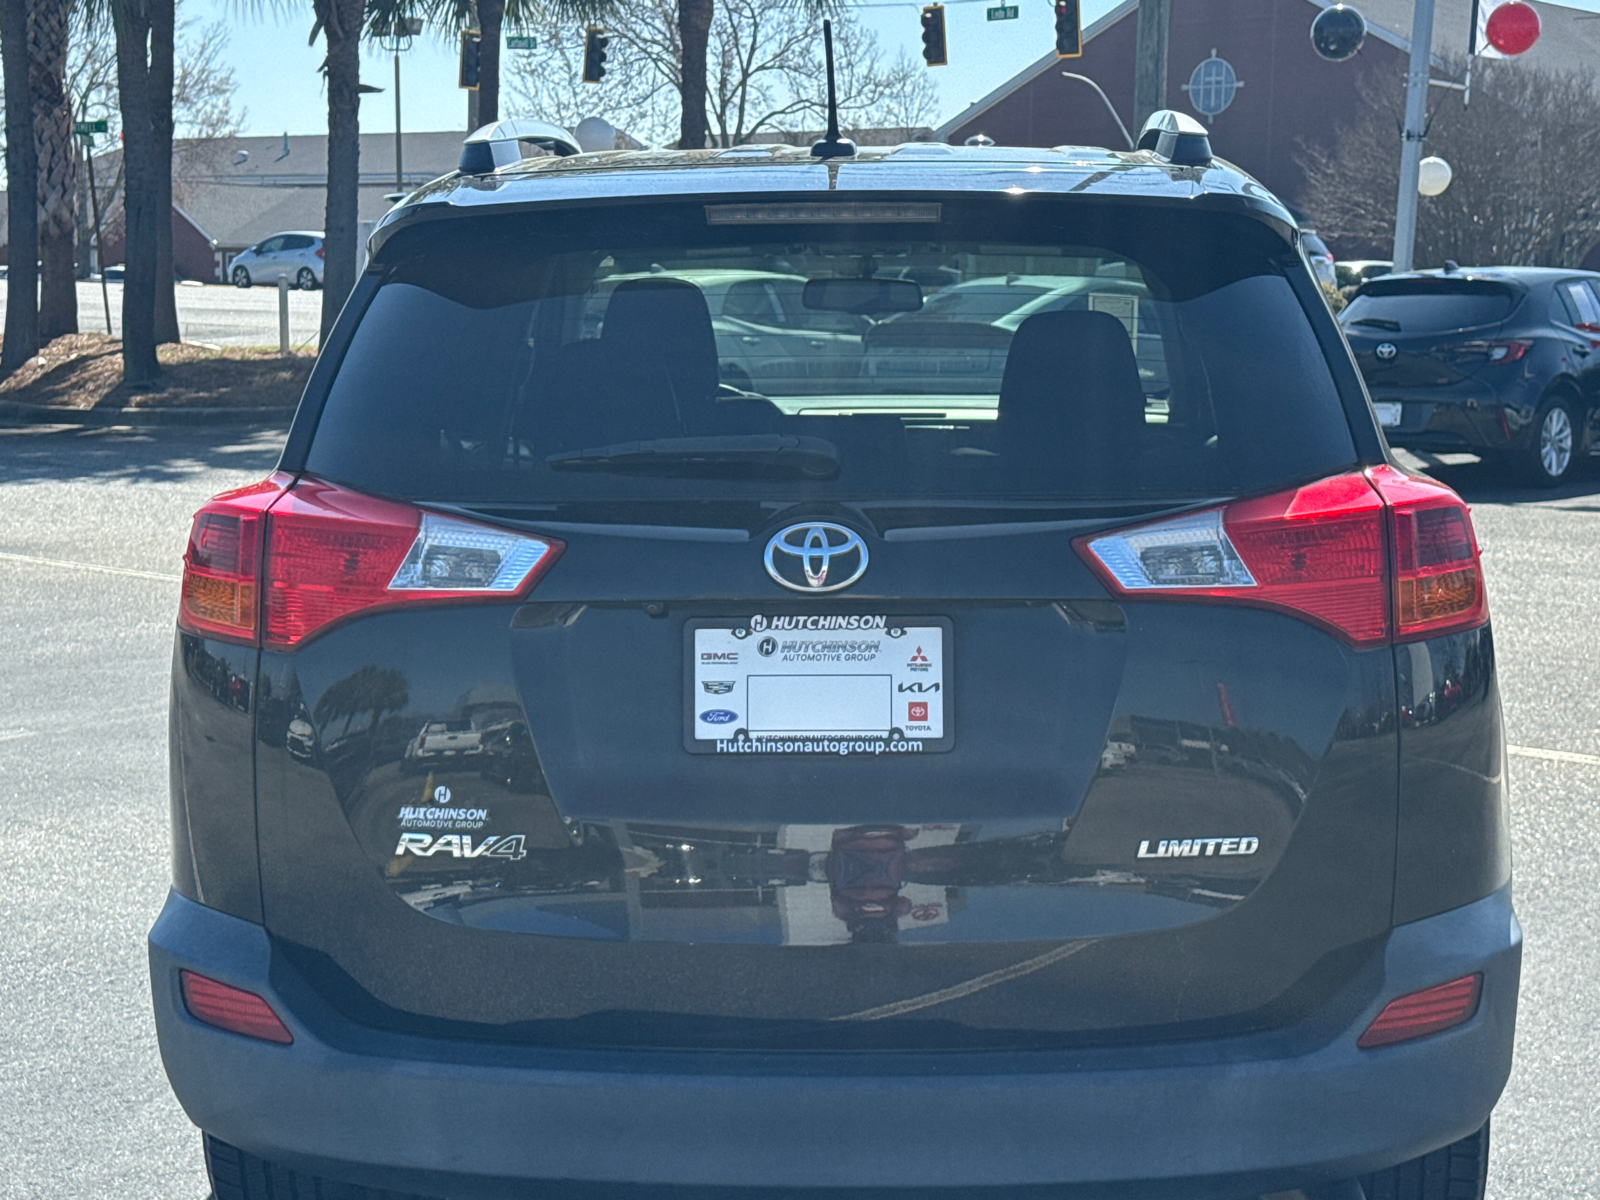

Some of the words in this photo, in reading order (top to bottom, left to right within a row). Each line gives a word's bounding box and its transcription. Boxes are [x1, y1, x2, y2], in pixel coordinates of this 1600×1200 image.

[771, 615, 887, 630] HUTCHINSON
[780, 640, 880, 653] HUTCHINSON
[782, 654, 843, 662] AUTOMOTIVE
[844, 654, 876, 662] GROUP
[716, 739, 923, 756] Hutchinsonautogroup.com
[398, 807, 487, 820] HUTCHINSON
[401, 820, 453, 828] AUTOMOTIVE
[456, 821, 484, 829] GROUP
[395, 832, 527, 860] RAV4
[1137, 836, 1259, 858] LIMITED
